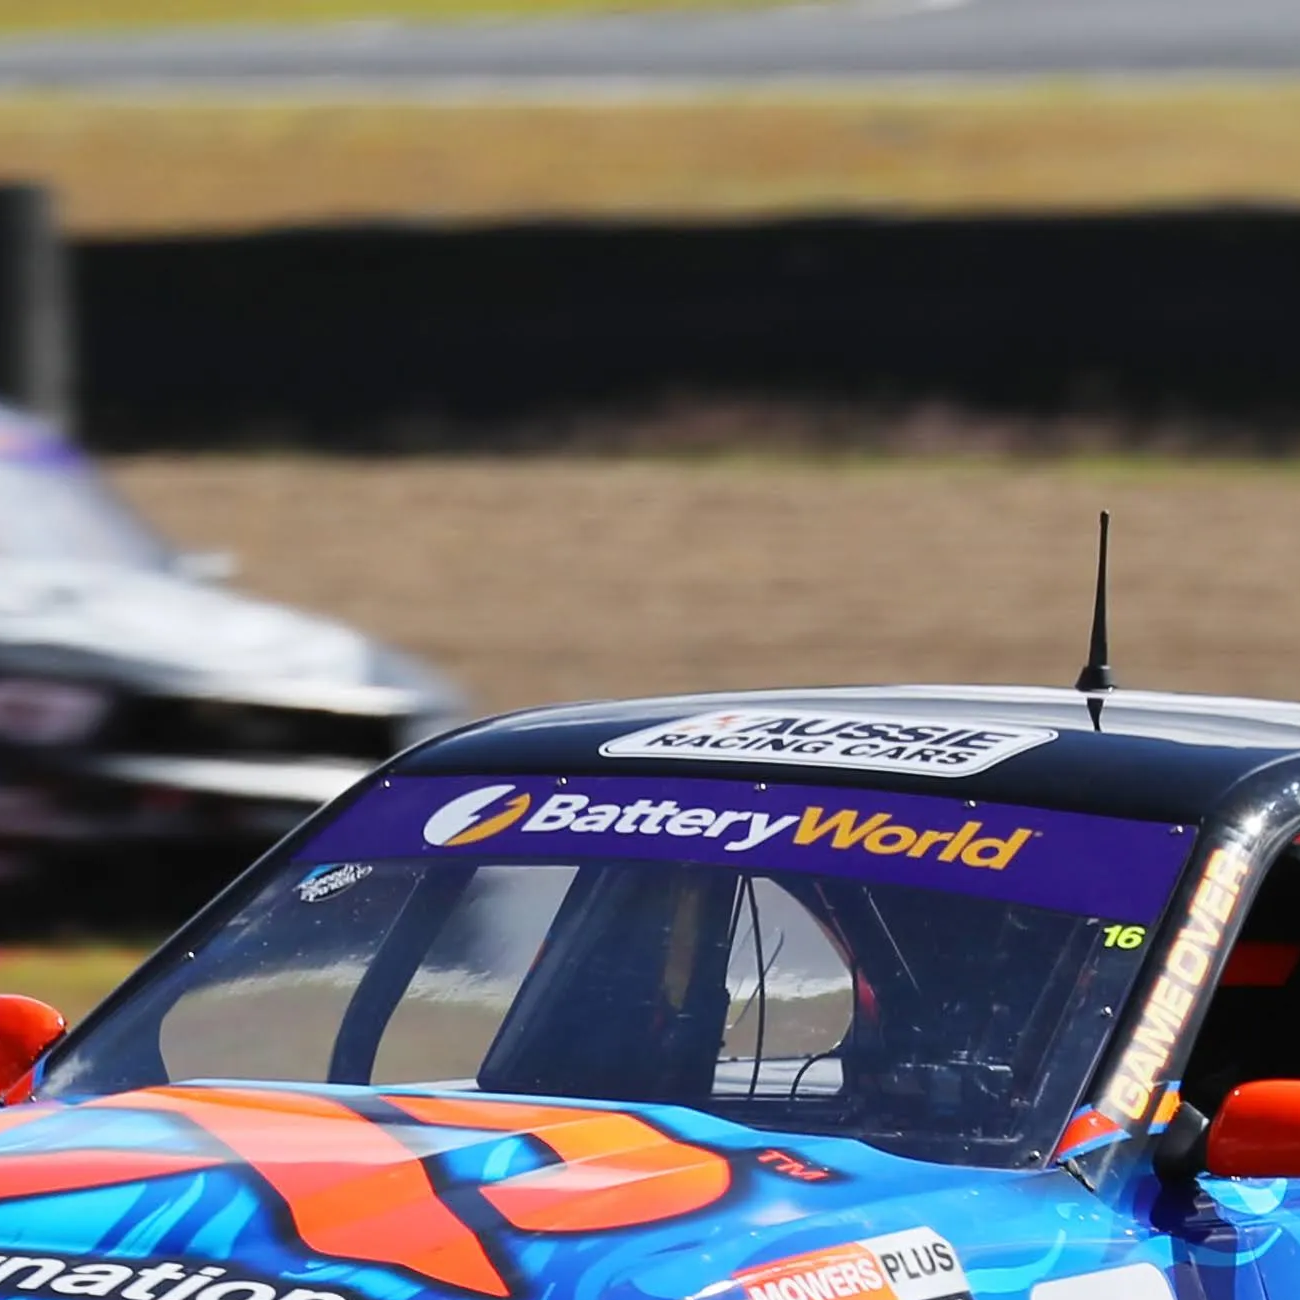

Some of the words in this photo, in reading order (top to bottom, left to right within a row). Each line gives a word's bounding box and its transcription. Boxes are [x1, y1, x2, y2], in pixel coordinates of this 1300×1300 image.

[647, 733, 829, 755] RACING
[840, 739, 980, 766] CARS
[734, 716, 1022, 751] AUSSIE
[1103, 924, 1146, 949] 16
[1109, 975, 1195, 1120] GAME
[880, 1242, 955, 1284] PLUS
